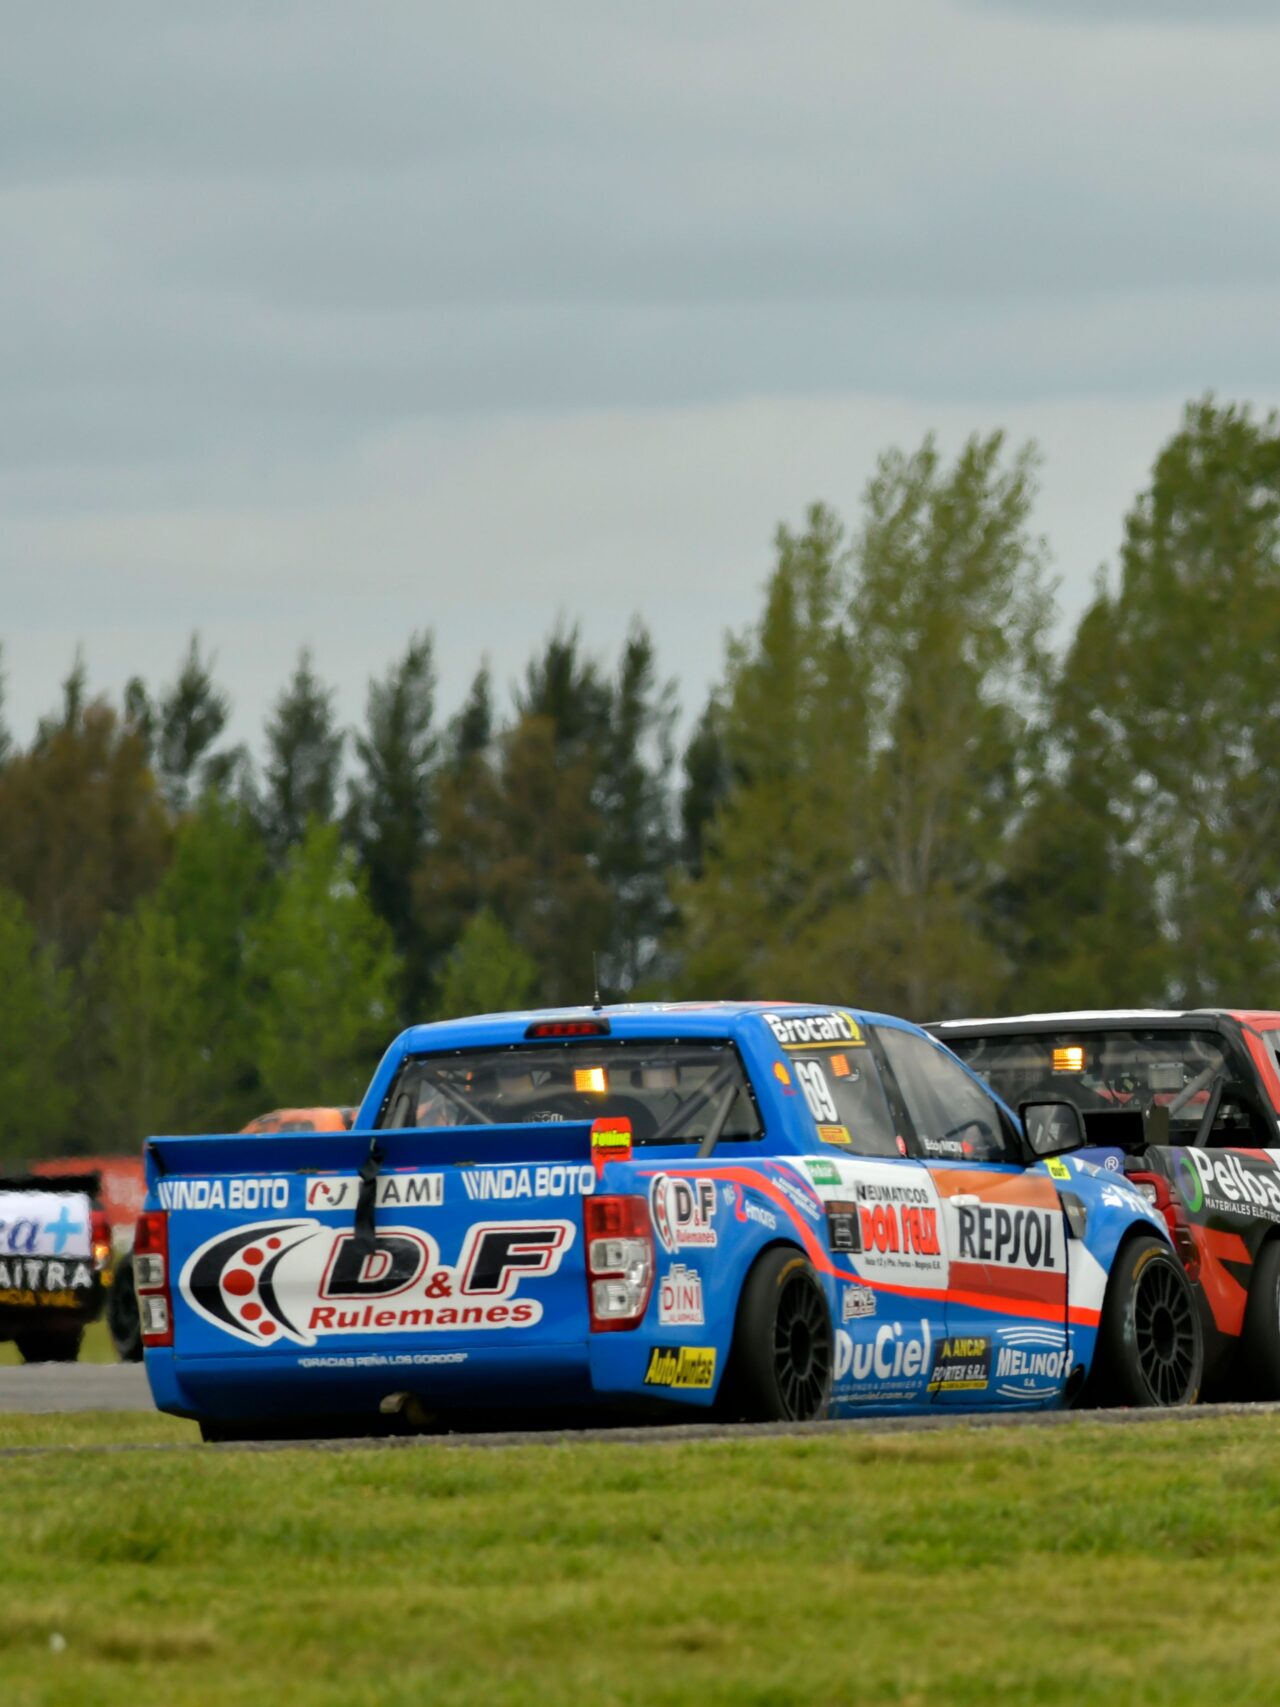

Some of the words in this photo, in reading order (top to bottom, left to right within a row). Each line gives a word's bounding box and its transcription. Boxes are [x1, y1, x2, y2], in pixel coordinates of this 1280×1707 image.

[762, 1012, 851, 1042] Brocart
[794, 1061, 838, 1121] 69
[229, 1179, 289, 1209] BOTO
[535, 1165, 596, 1196] BOTO
[856, 1184, 929, 1203] NEUMATICOS
[1205, 1198, 1251, 1215] MATERIALES
[960, 1207, 1055, 1267] REPSOL
[663, 1285, 700, 1311] DINI
[308, 1303, 533, 1329] Rulemanes
[389, 1354, 412, 1365] LOS
[834, 1319, 931, 1381] DuCiel
